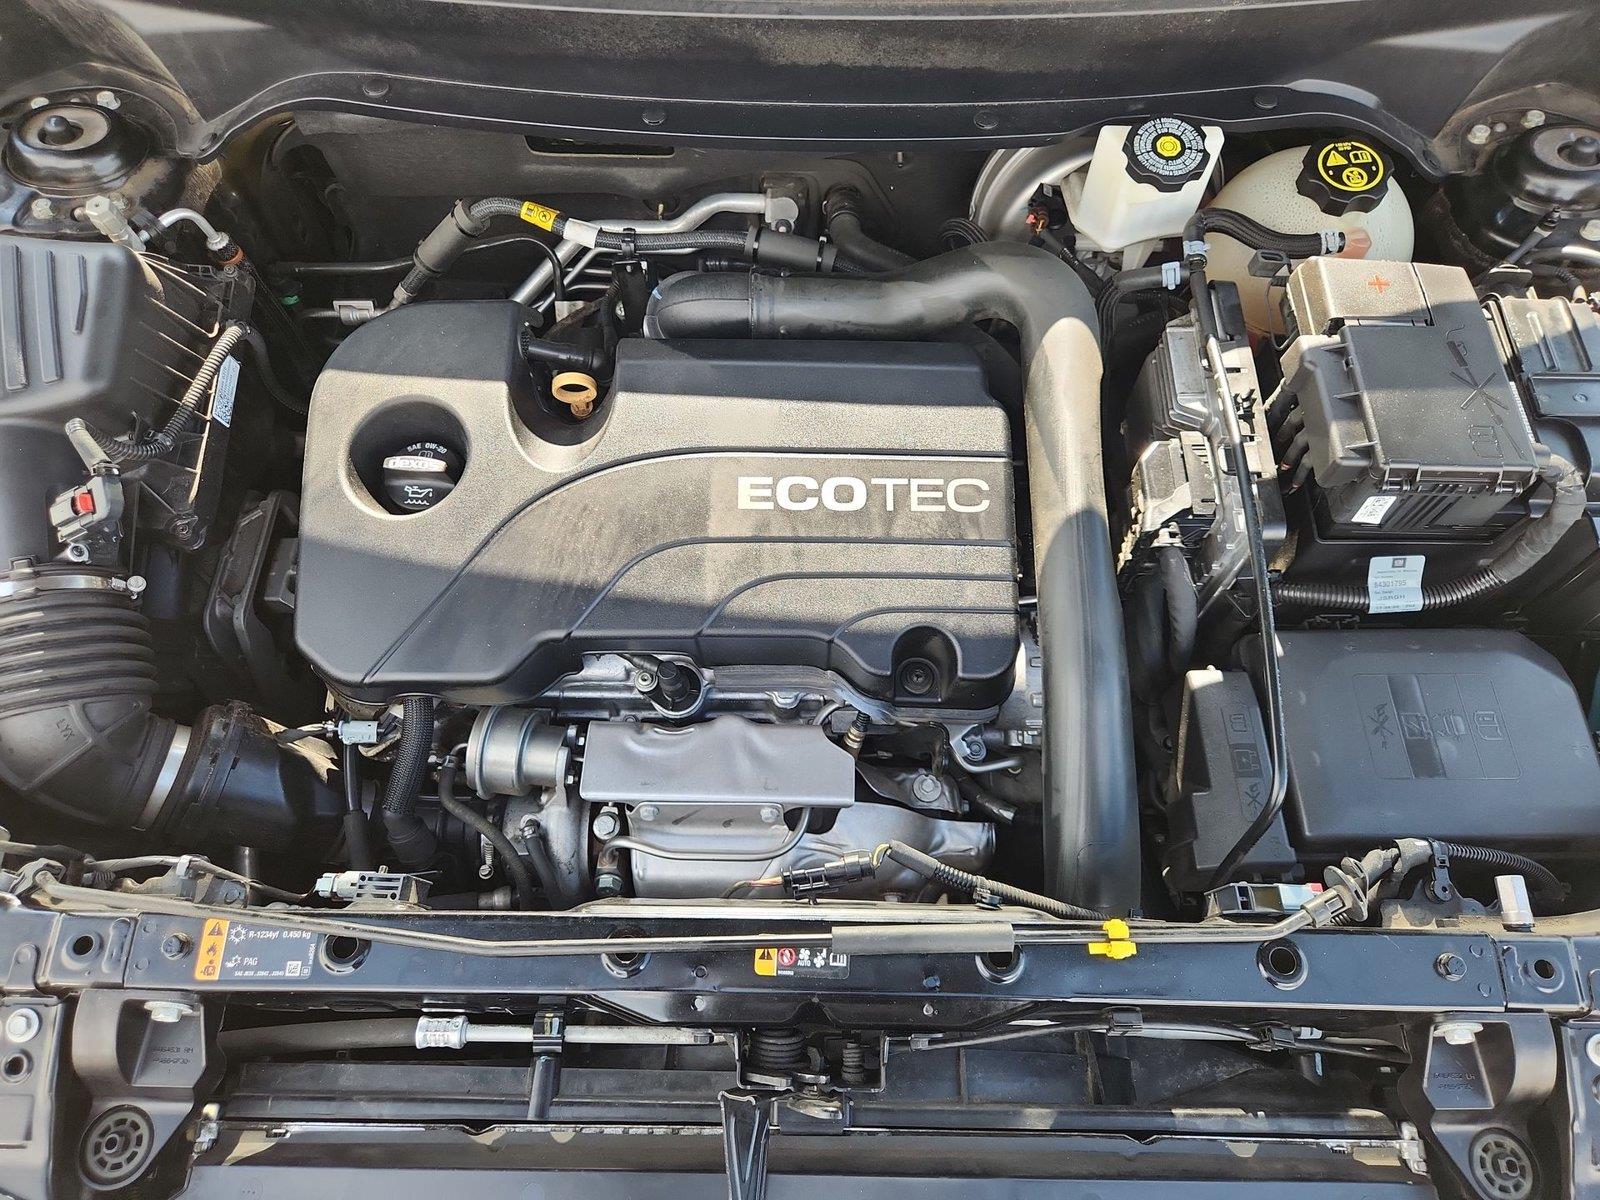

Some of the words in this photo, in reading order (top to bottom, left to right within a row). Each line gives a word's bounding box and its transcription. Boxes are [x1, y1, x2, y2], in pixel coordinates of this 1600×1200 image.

[407, 443, 421, 452] SAE
[737, 476, 991, 513] ECOTEC
[248, 930, 280, 940] R-1234yf
[282, 930, 302, 939] 0.450
[302, 930, 312, 940] kg
[243, 957, 258, 966] PAG
